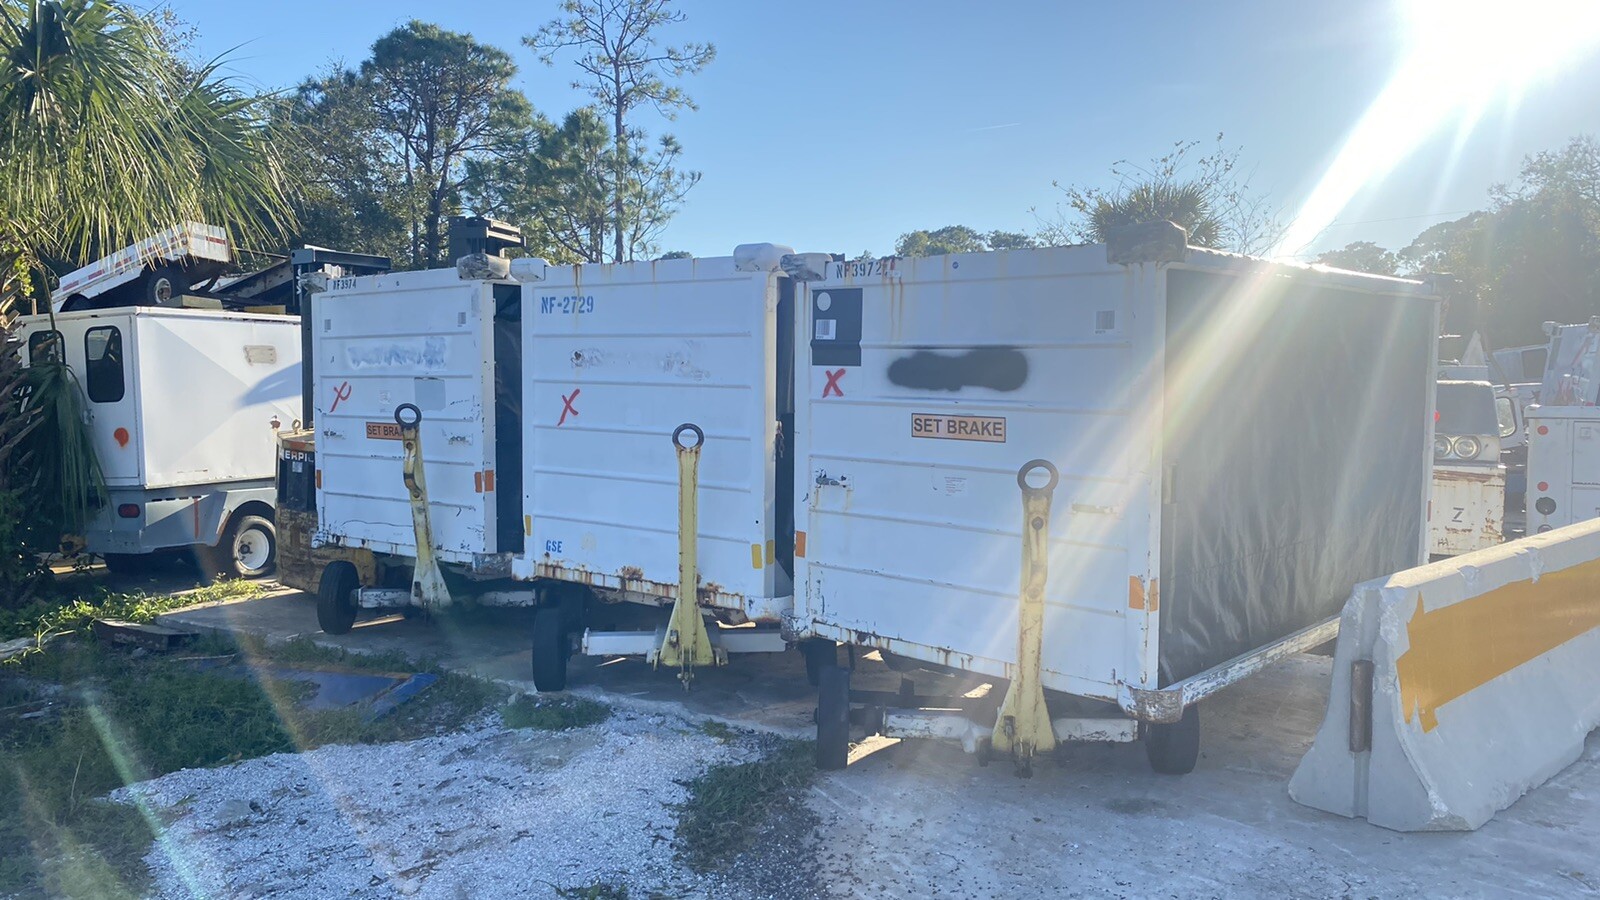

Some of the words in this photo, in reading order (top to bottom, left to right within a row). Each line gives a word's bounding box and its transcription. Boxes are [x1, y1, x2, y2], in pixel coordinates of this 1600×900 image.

[541, 295, 594, 314] NF-2729
[367, 425, 381, 435] SET
[383, 426, 401, 437] BRA
[913, 418, 942, 433] SET
[947, 420, 1003, 437] BRAKE
[284, 450, 314, 463] ERPIL
[546, 540, 562, 553] GSE
